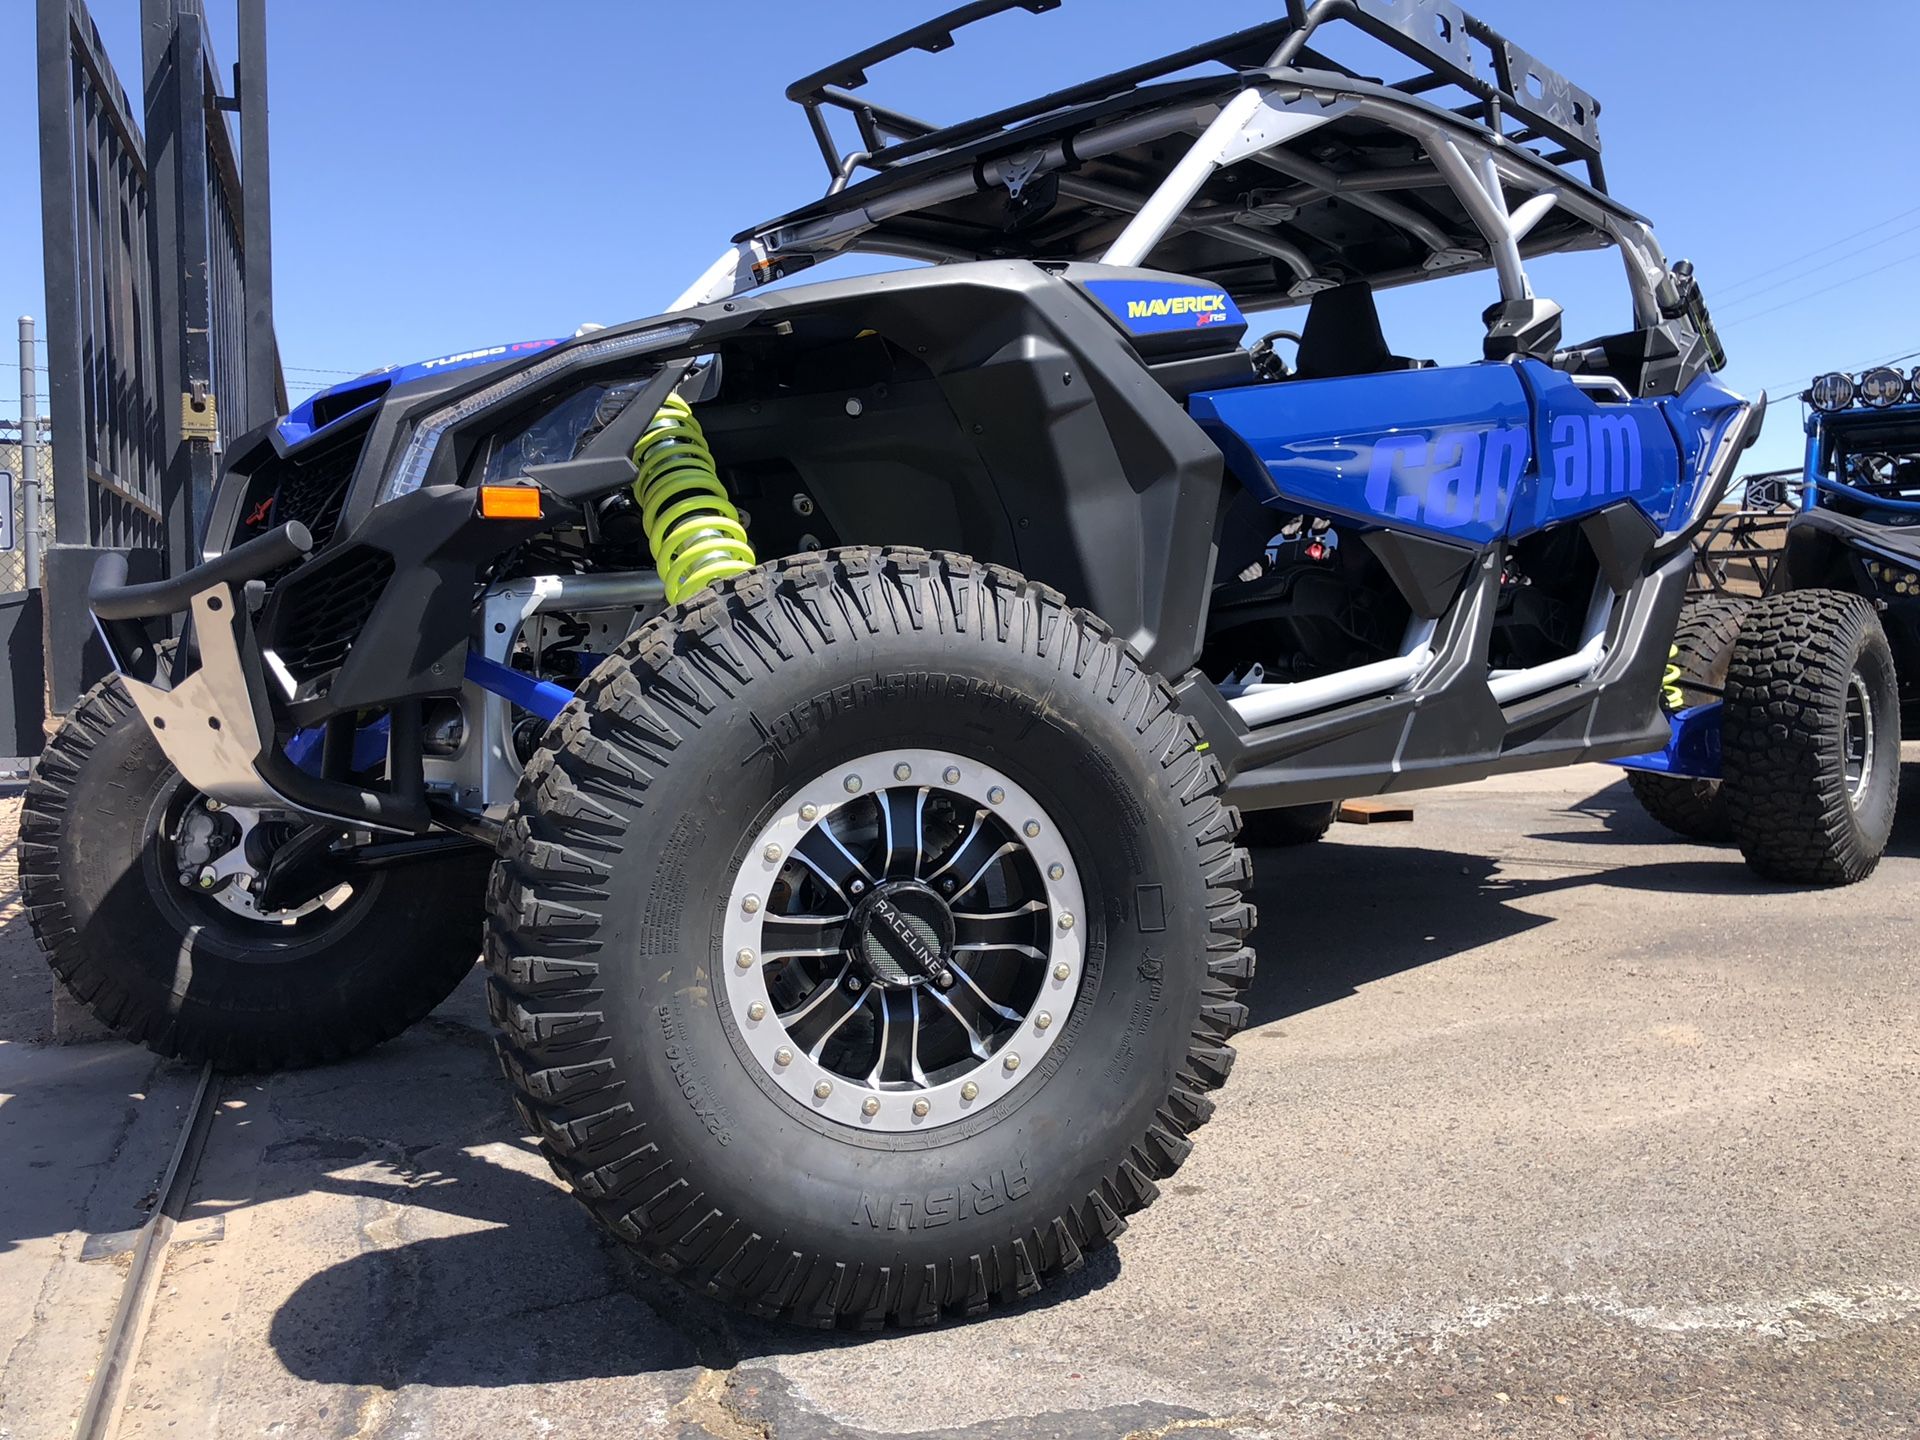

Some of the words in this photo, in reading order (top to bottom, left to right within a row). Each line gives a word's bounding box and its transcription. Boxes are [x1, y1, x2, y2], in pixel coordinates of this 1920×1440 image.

[1127, 294, 1226, 318] MAVERICK
[421, 346, 507, 369] TURBO
[875, 899, 941, 974] RACELINE
